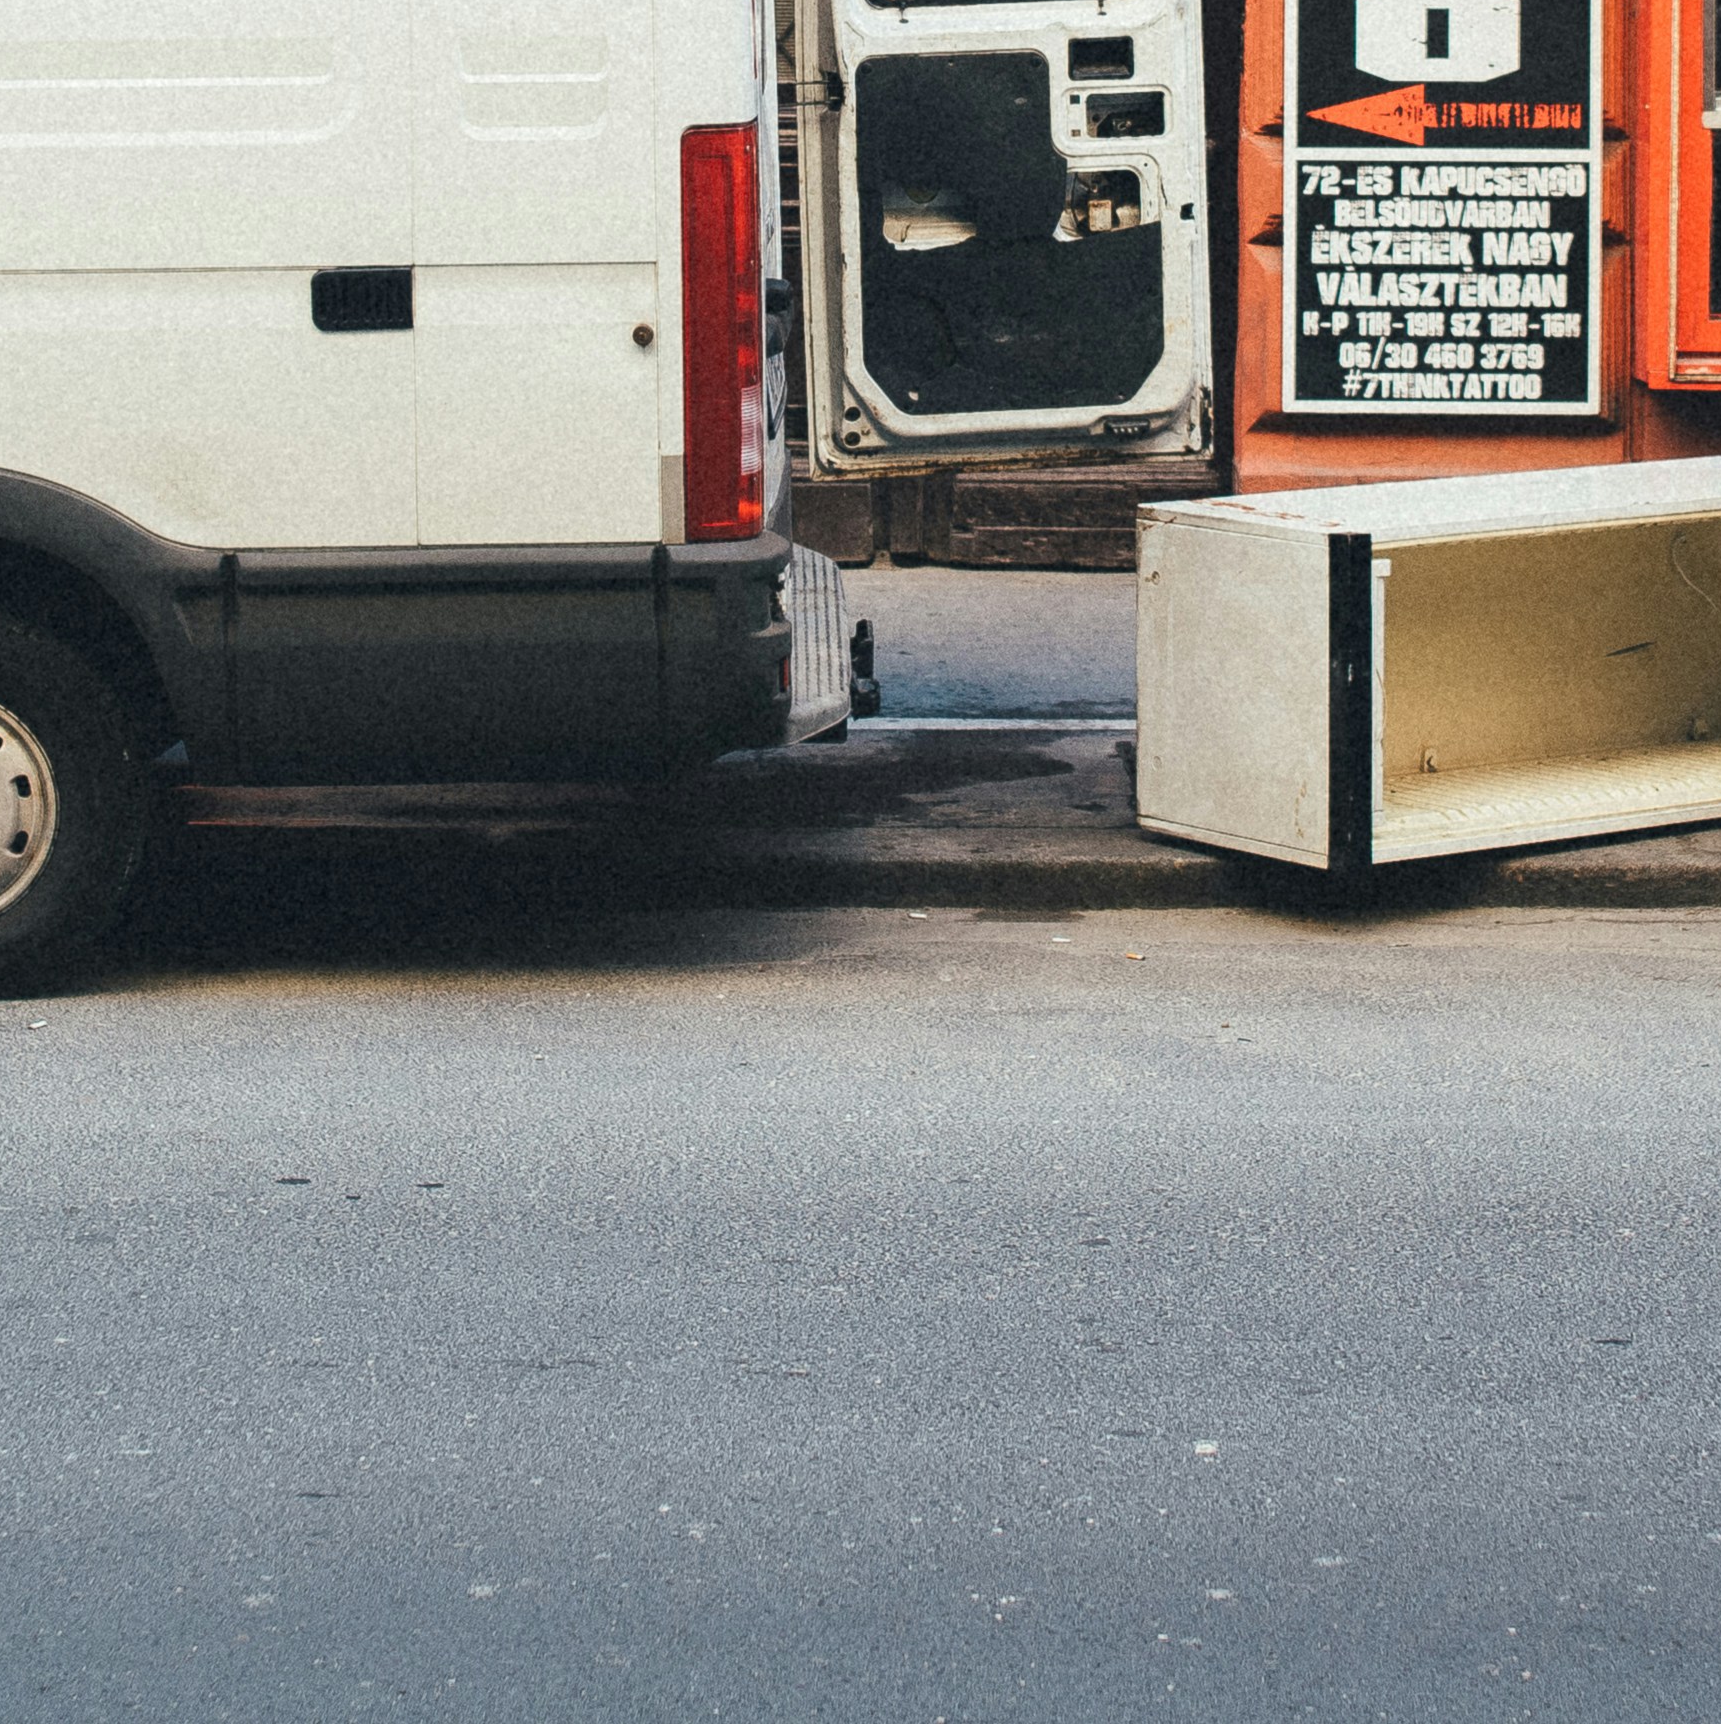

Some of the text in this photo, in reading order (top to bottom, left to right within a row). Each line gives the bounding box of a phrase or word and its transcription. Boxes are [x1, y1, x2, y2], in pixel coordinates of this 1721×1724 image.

[1302, 165, 1393, 195] 72-ES
[1483, 232, 1573, 265] NAGY
[1451, 313, 1481, 336] SZ
[1339, 336, 1544, 369] 06/30 460 3769
